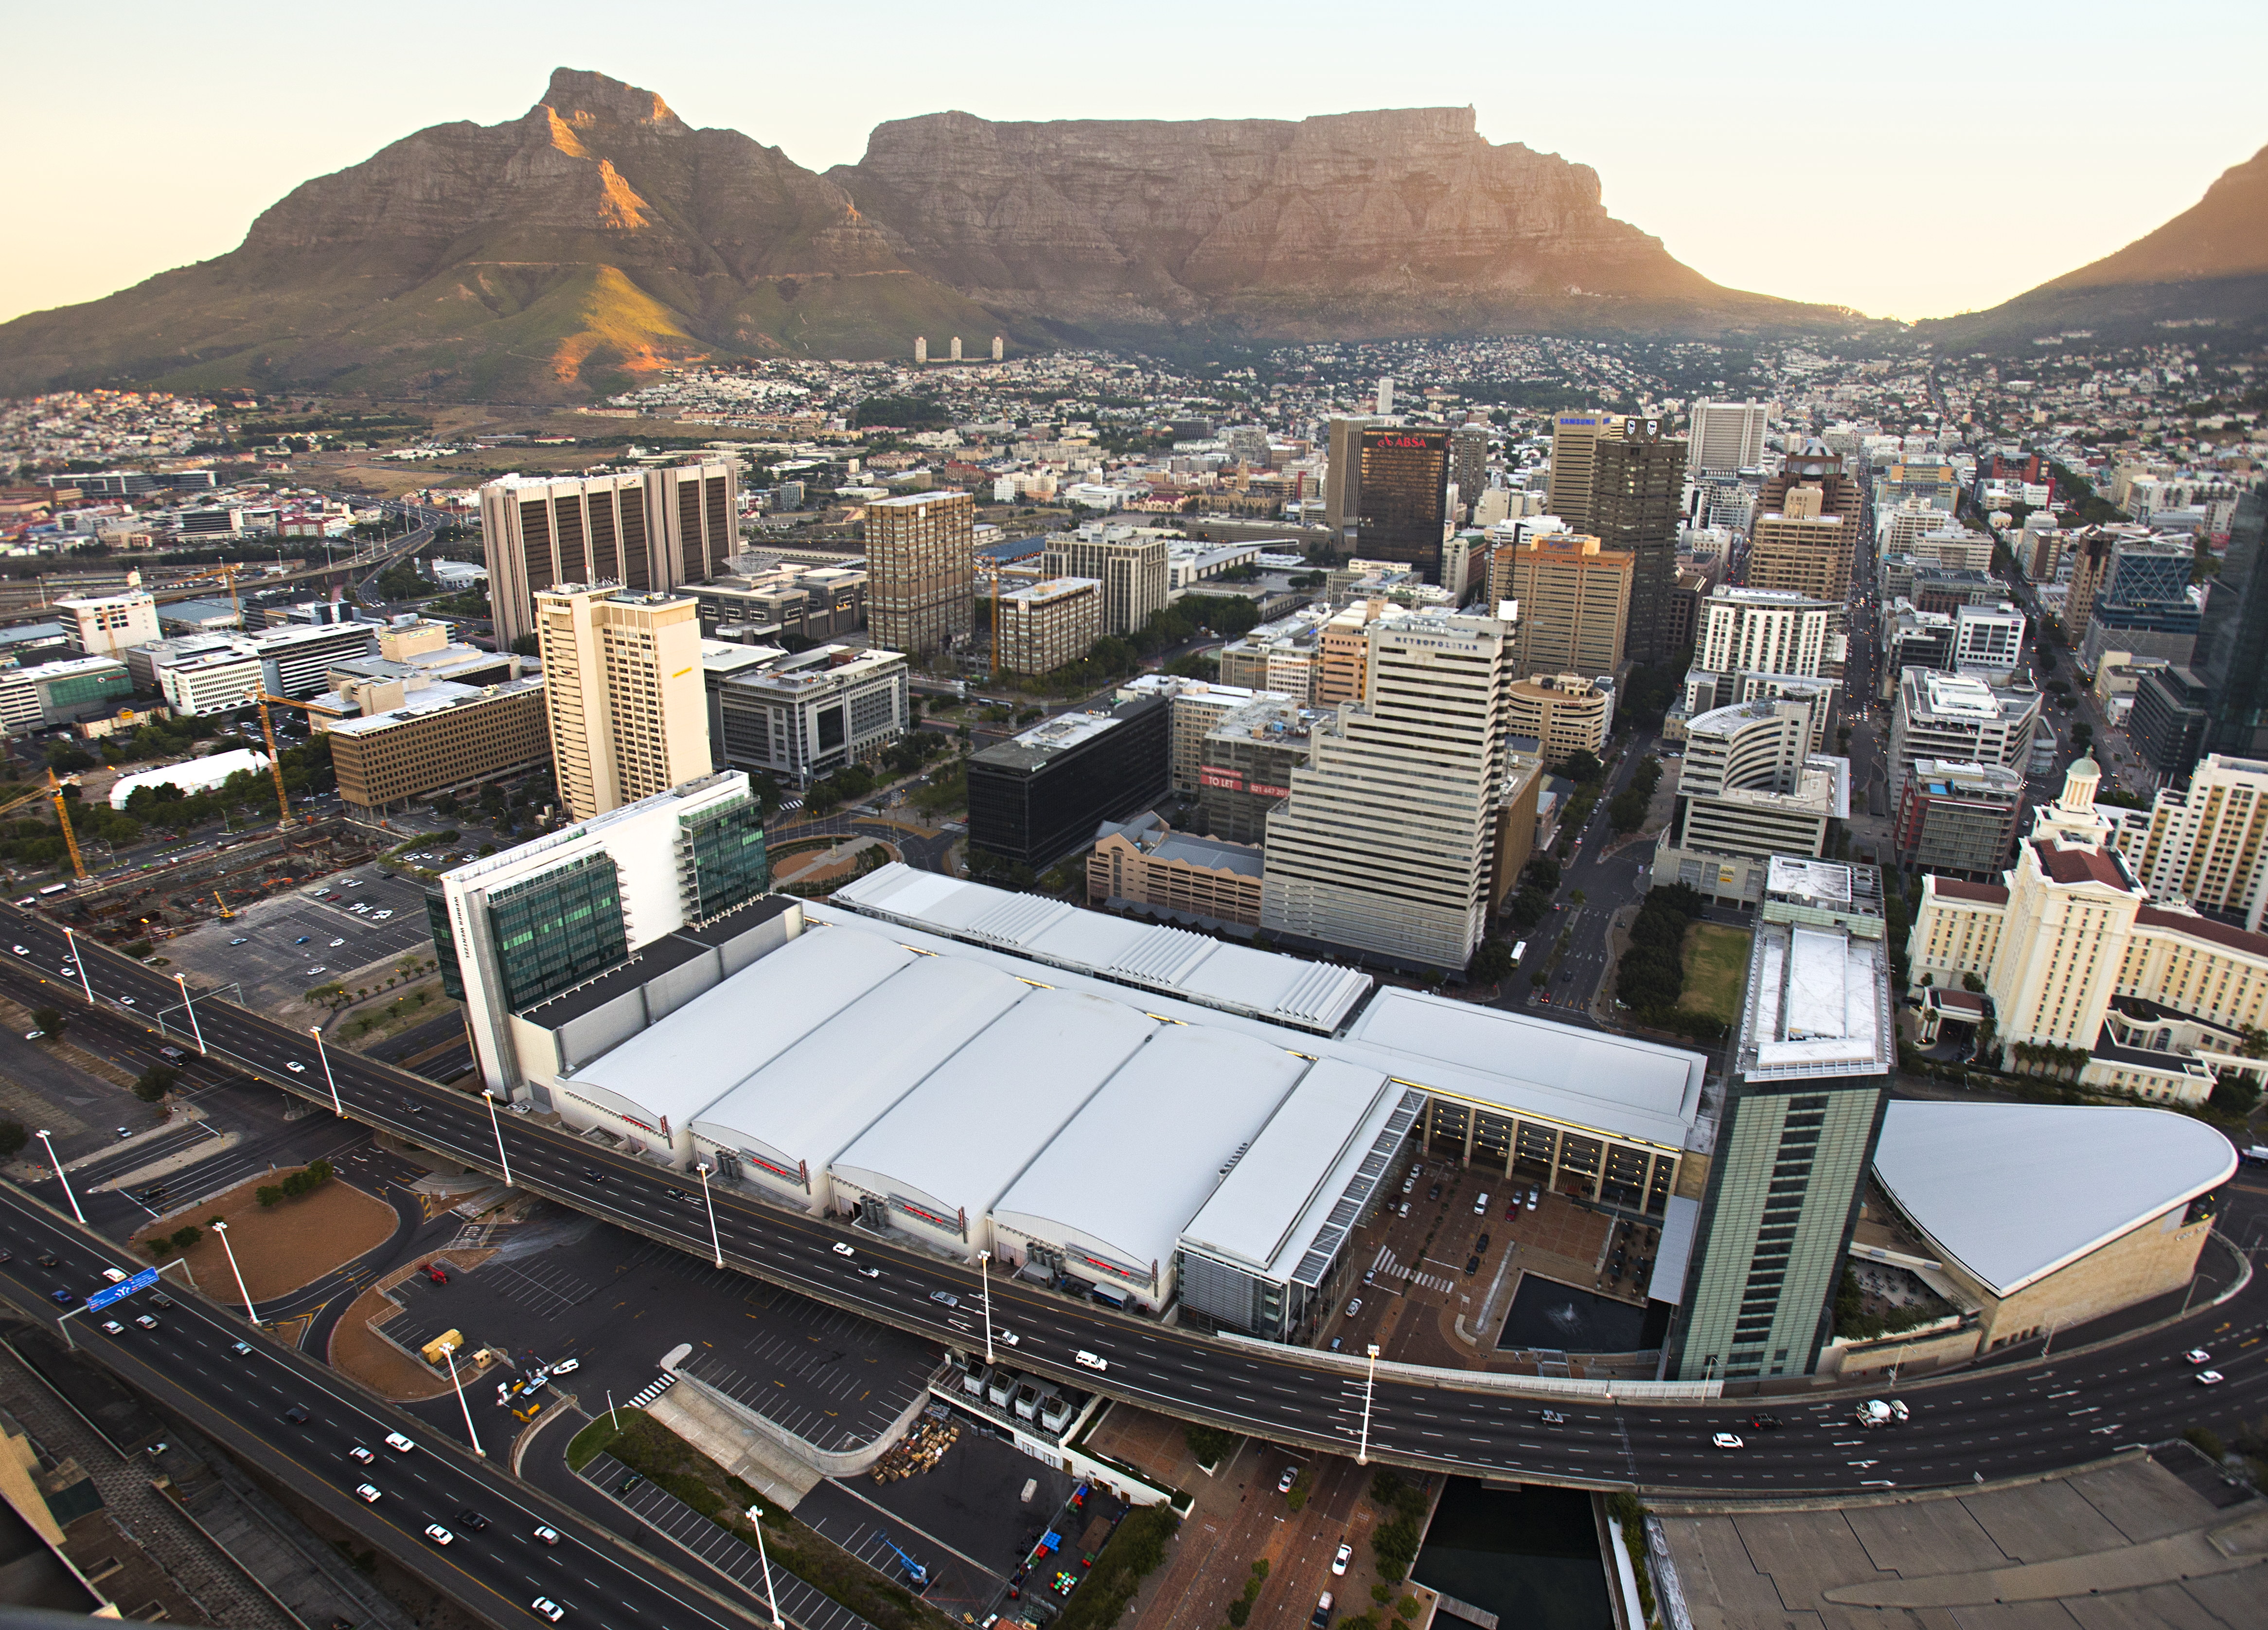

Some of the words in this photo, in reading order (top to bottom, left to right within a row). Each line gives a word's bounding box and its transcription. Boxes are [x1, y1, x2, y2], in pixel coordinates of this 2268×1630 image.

[1395, 437, 1427, 448] ABSA
[1395, 637, 1477, 651] METROPOLITAN
[1208, 776, 1220, 786] TO
[1221, 778, 1234, 788] LET
[454, 897, 463, 925] WEBBER
[460, 928, 469, 958] WENTZEL
